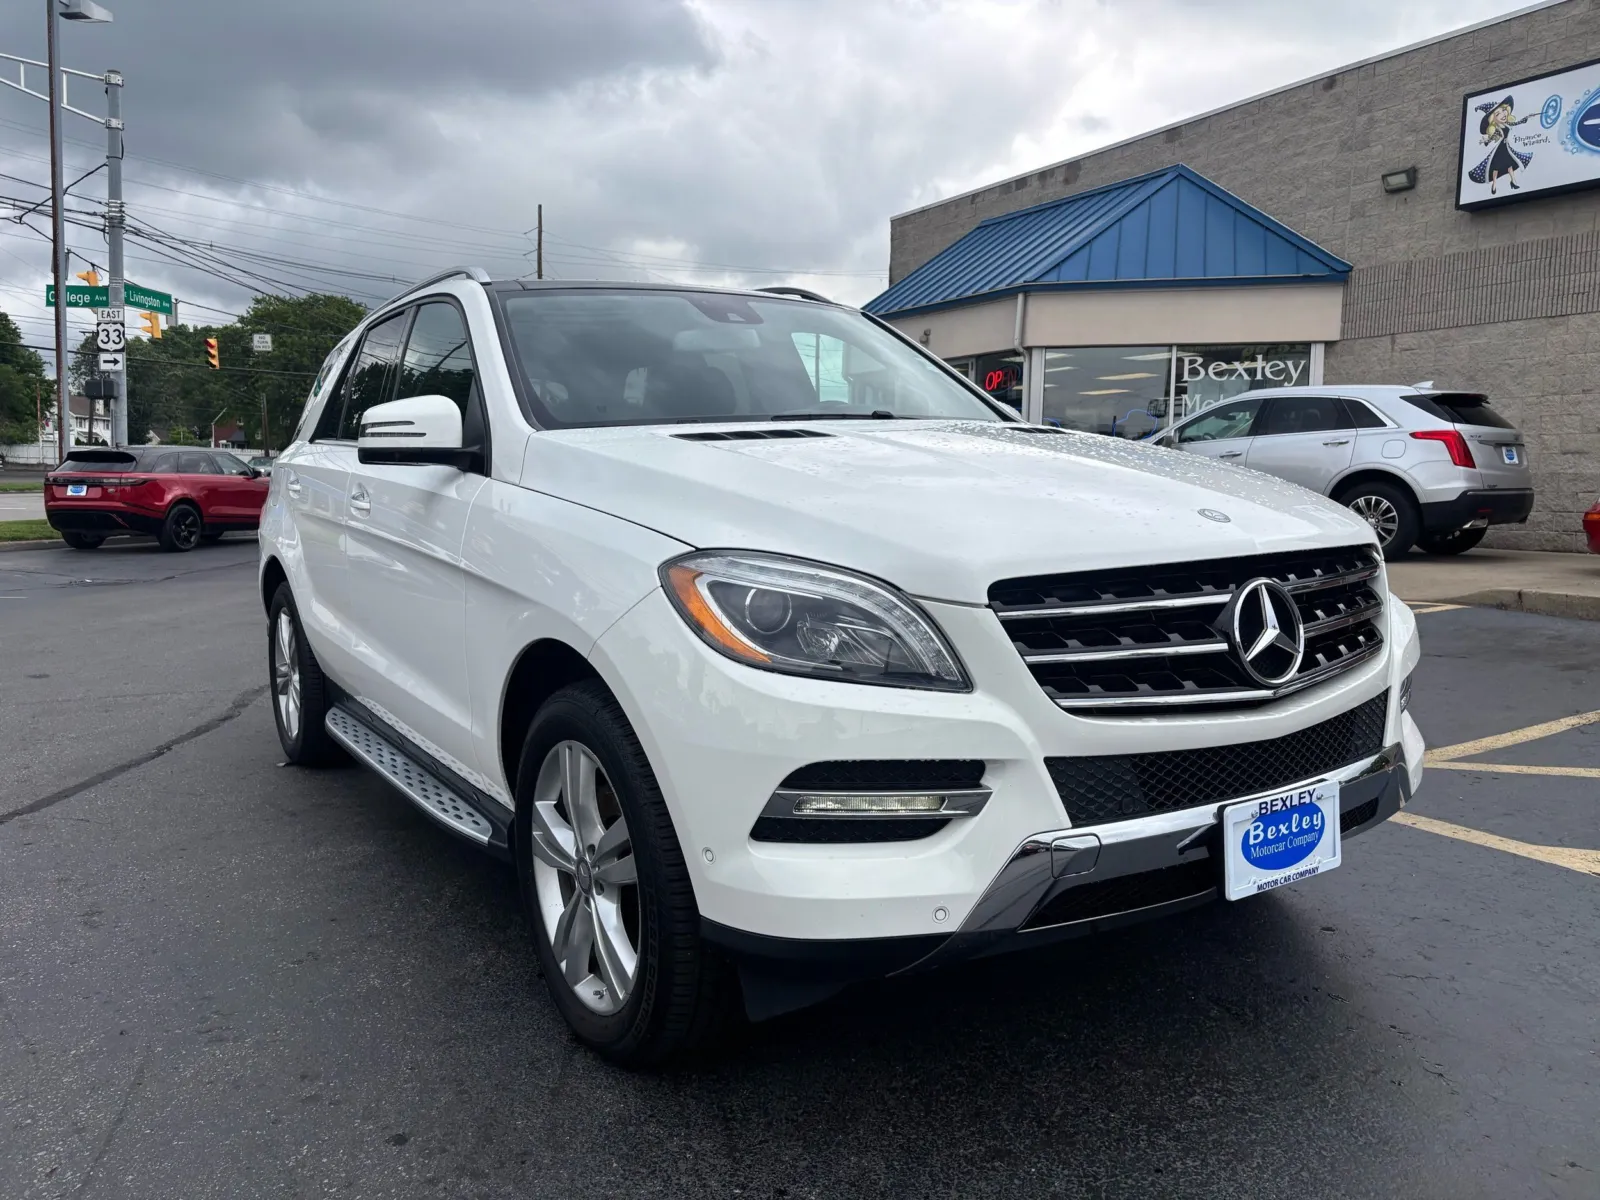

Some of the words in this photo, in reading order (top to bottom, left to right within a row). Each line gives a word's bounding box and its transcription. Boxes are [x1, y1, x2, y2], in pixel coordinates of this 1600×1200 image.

[49, 291, 90, 306] Clege
[130, 290, 160, 308] Livingston
[101, 310, 120, 319] EAST
[100, 328, 121, 345] 33
[1181, 354, 1306, 387] Bexley
[1258, 788, 1316, 815] BEXLEY
[1249, 812, 1321, 845] Bexley
[1250, 842, 1286, 859] Motorcar
[1287, 831, 1320, 848] Company
[1257, 878, 1278, 892] MOTOR
[1280, 874, 1292, 884] CAR
[1292, 866, 1320, 881] COMPANY
